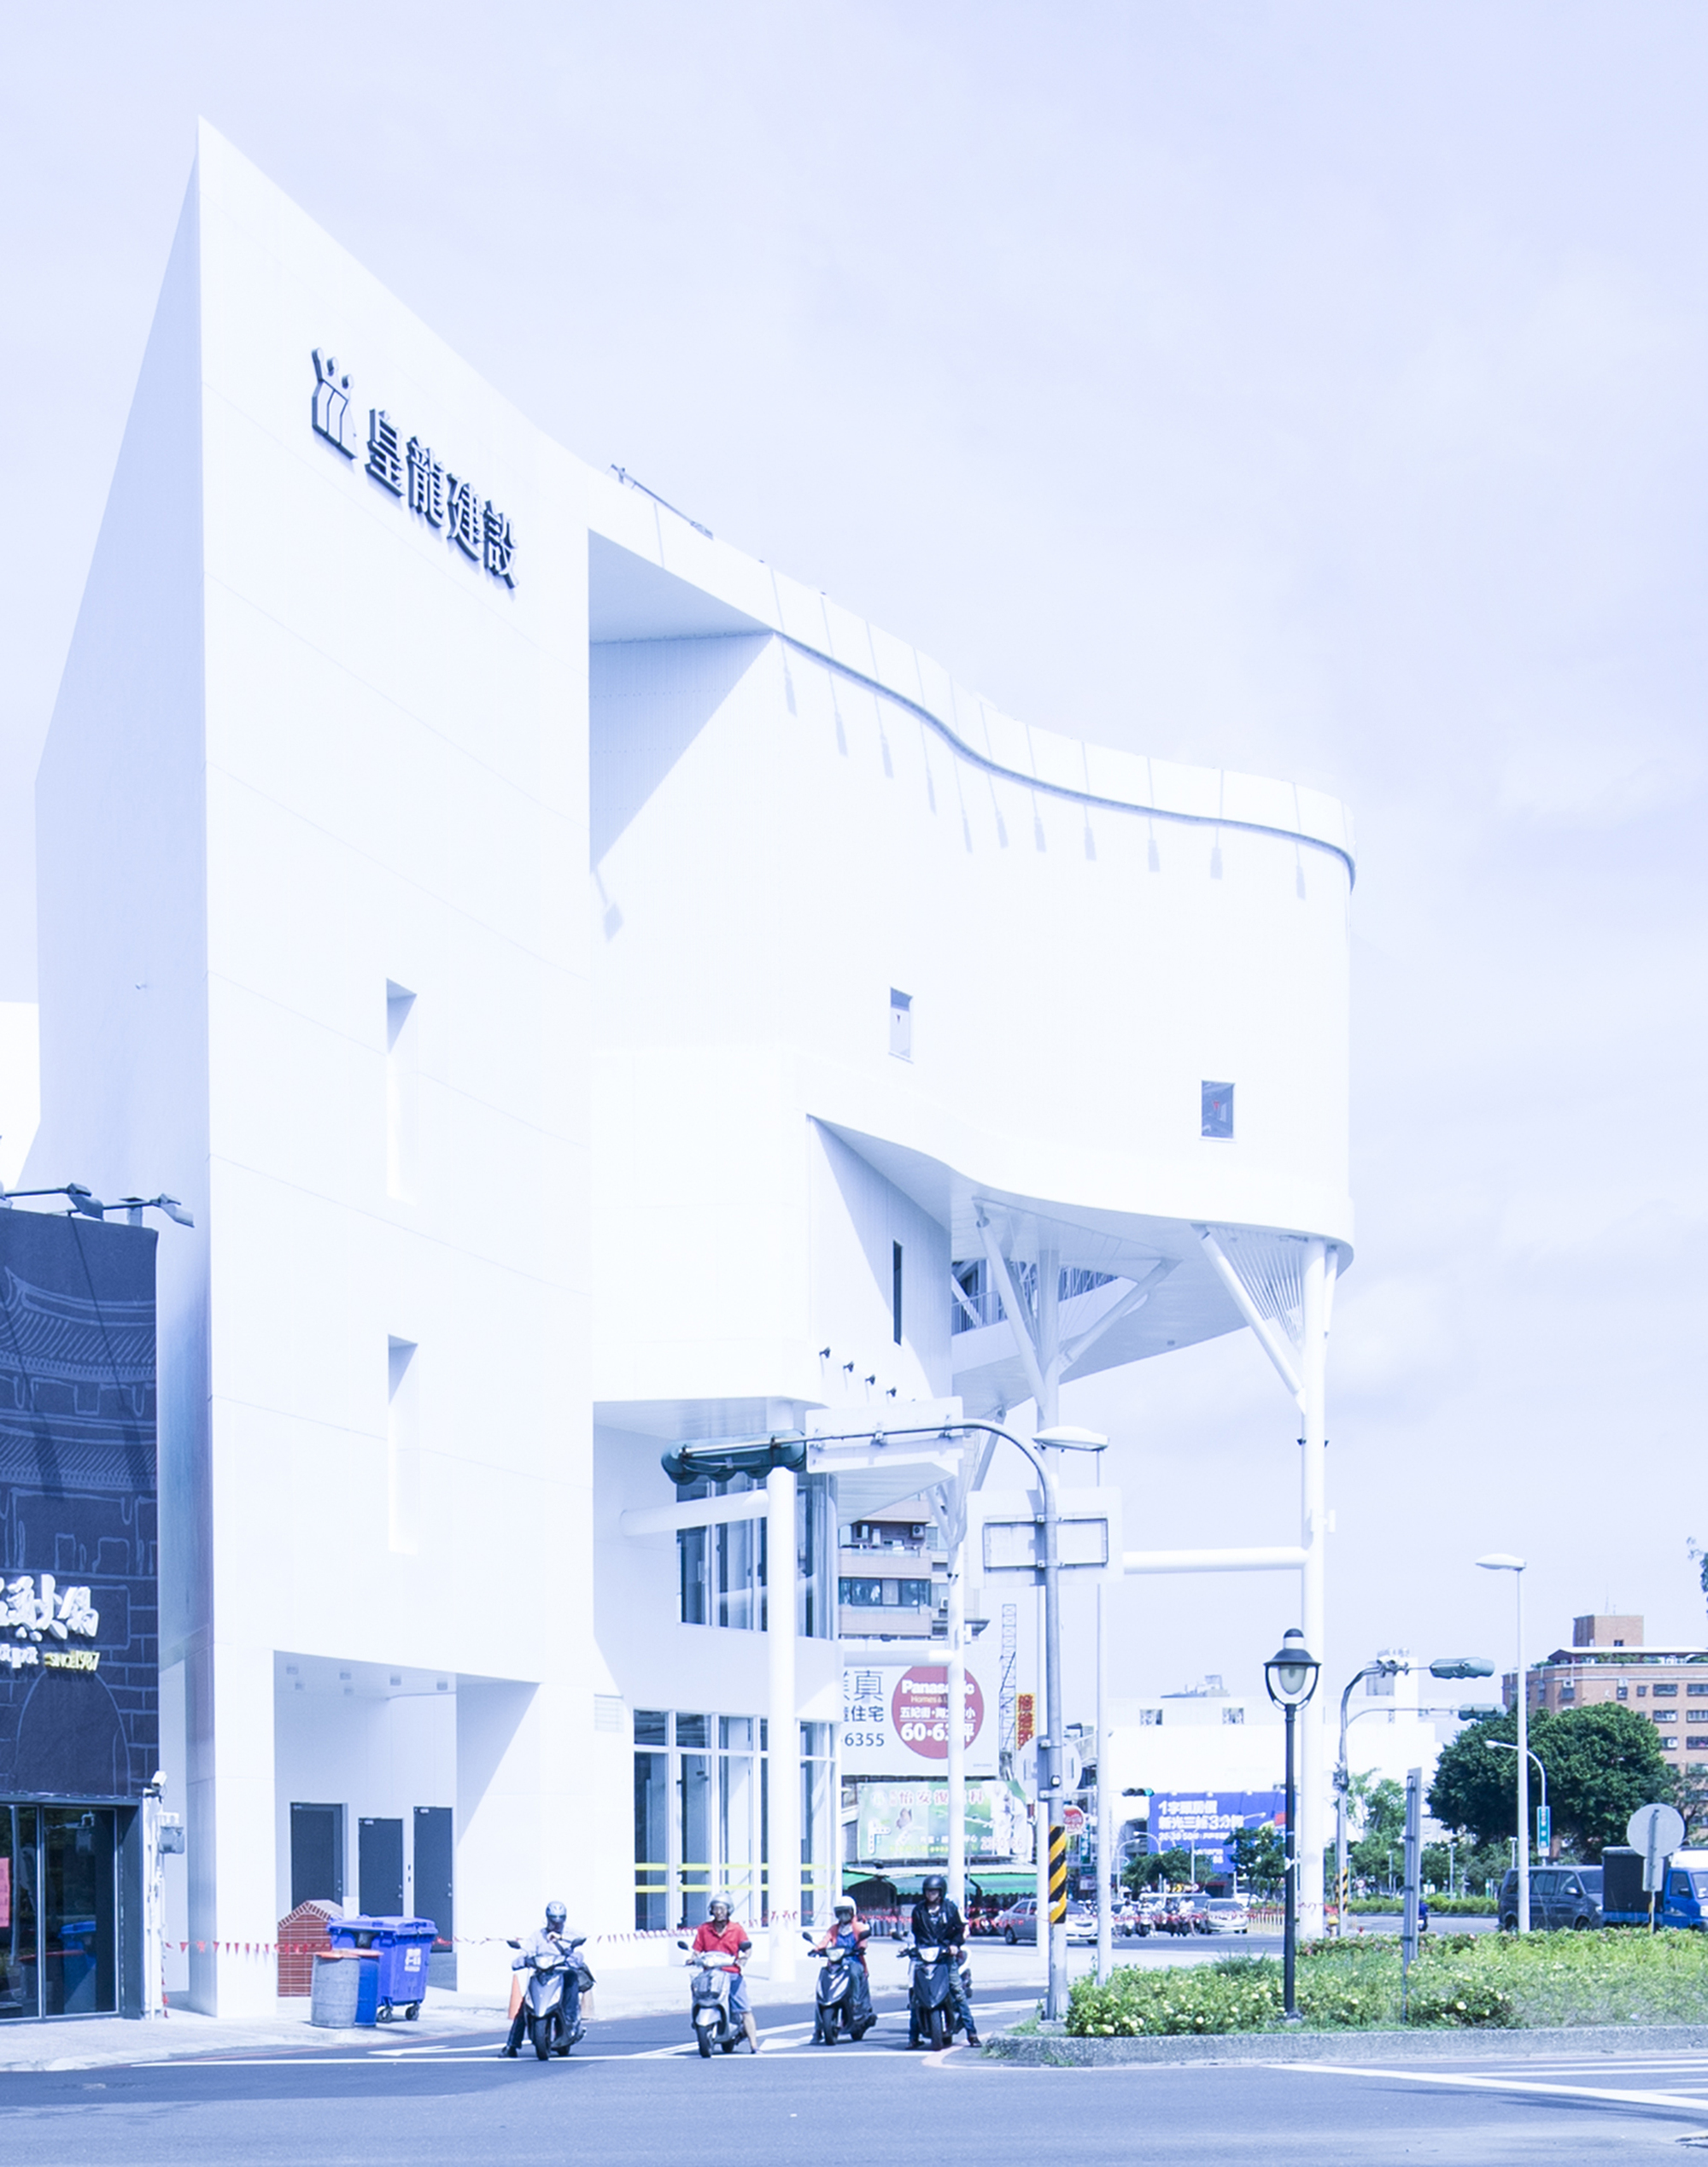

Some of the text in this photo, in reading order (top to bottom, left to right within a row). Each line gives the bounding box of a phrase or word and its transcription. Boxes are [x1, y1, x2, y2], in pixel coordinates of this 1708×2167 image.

[365, 407, 518, 590] 皇龍建設
[902, 1679, 974, 1696] Panasc
